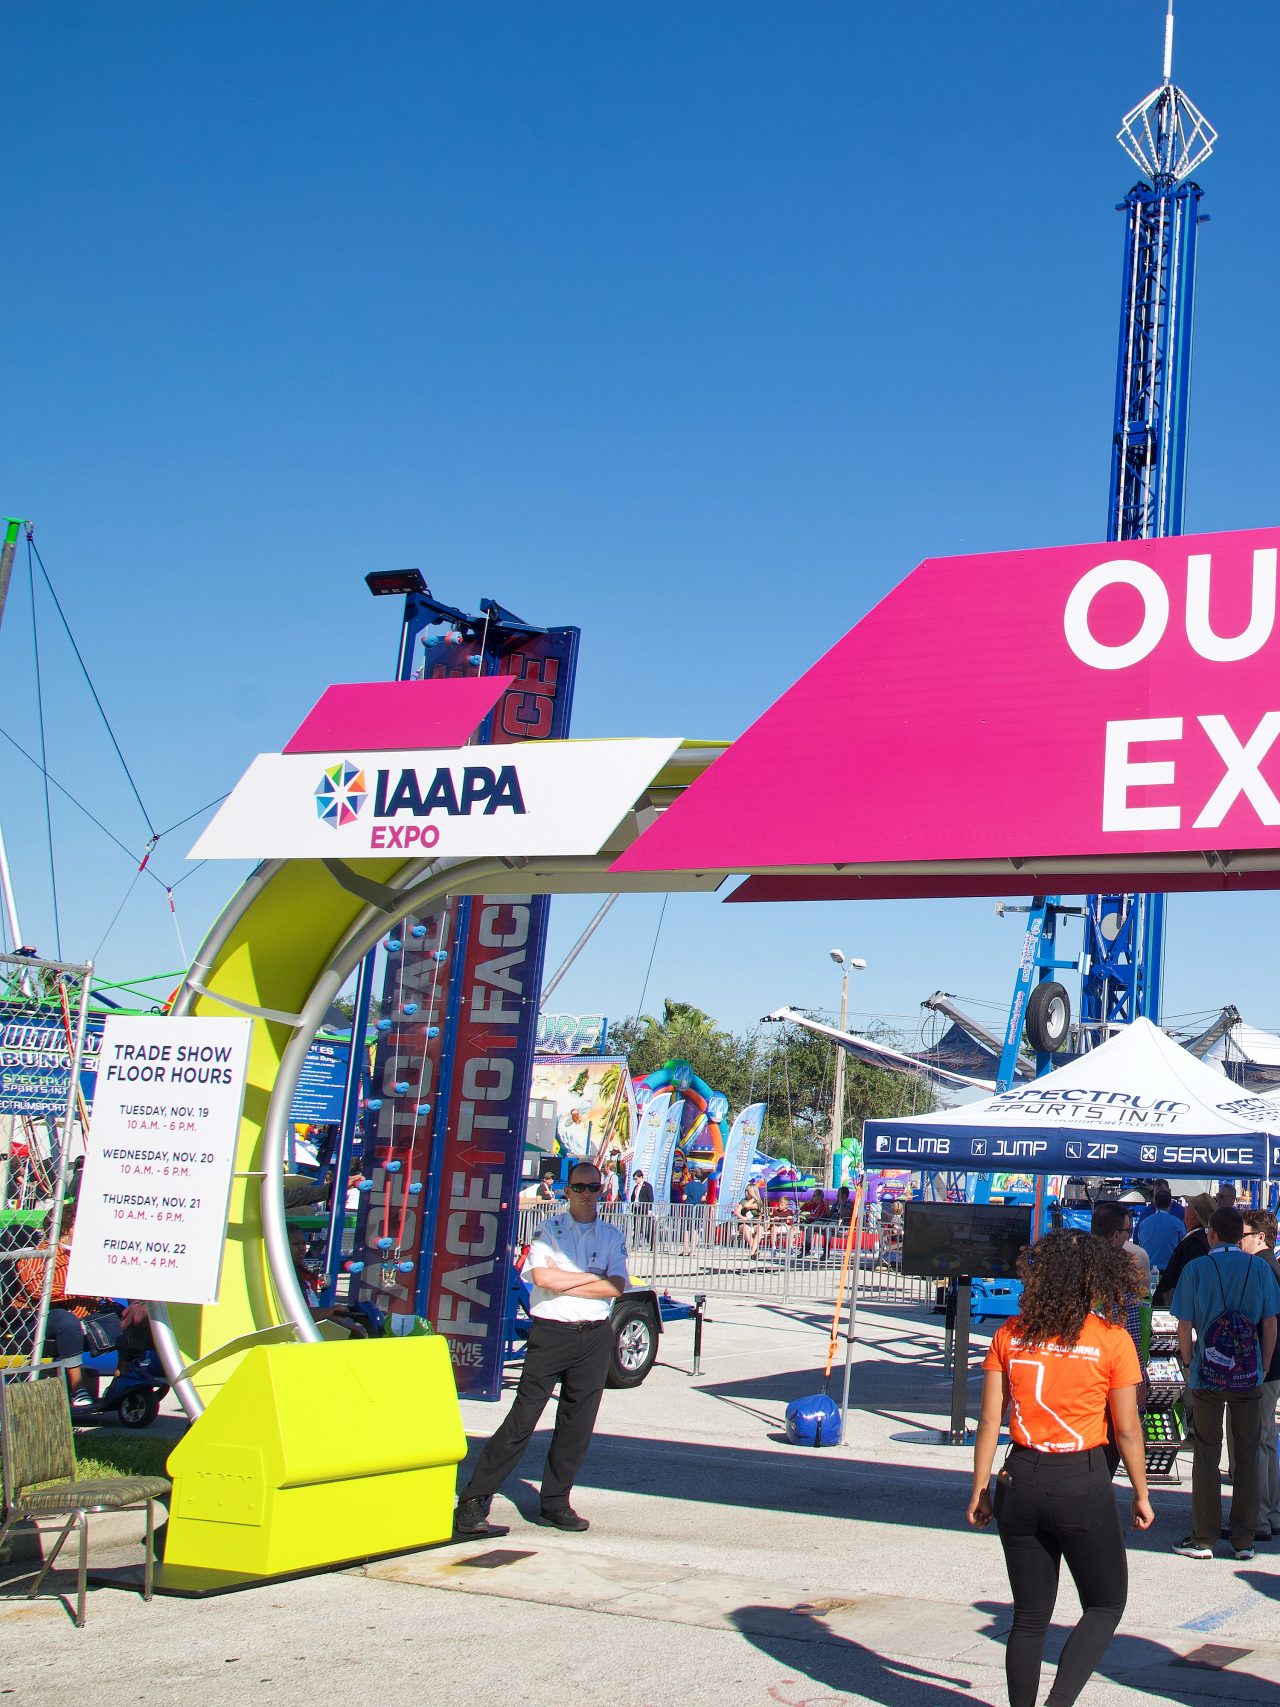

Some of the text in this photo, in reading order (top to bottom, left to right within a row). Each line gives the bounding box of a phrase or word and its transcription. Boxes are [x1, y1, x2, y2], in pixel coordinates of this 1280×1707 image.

[374, 765, 526, 817] IAAPA
[370, 825, 440, 848] EXPO
[469, 894, 533, 1024] FAC
[535, 1013, 604, 1054] URF
[114, 1044, 232, 1063] TRADE SHOW
[107, 1065, 232, 1084] FLOOR HOURS
[456, 1057, 514, 1141] TO
[1000, 1089, 1191, 1114] SPECTRUM
[120, 1105, 208, 1118] TUESDAY, NOV. 19
[984, 1103, 1103, 1119] SPORTS
[127, 1120, 197, 1131] 10 A.M. 6 P.M.
[102, 1149, 214, 1163] WEDNESDAY, NOV. 20
[896, 1137, 1253, 1164] CLIMB JUMP ZIP SERVICE
[120, 1164, 191, 1177] 10 A.M. 6 P.M.
[102, 1193, 200, 1208] THURSDAY, NOV. 21
[114, 1209, 184, 1222] 10 A.M. 6 P.M.
[103, 1239, 186, 1254] FRIDAY, NOV. 22
[436, 1172, 503, 1337] FACE
[107, 1255, 178, 1268] 10 A.M. 4 P.M.
